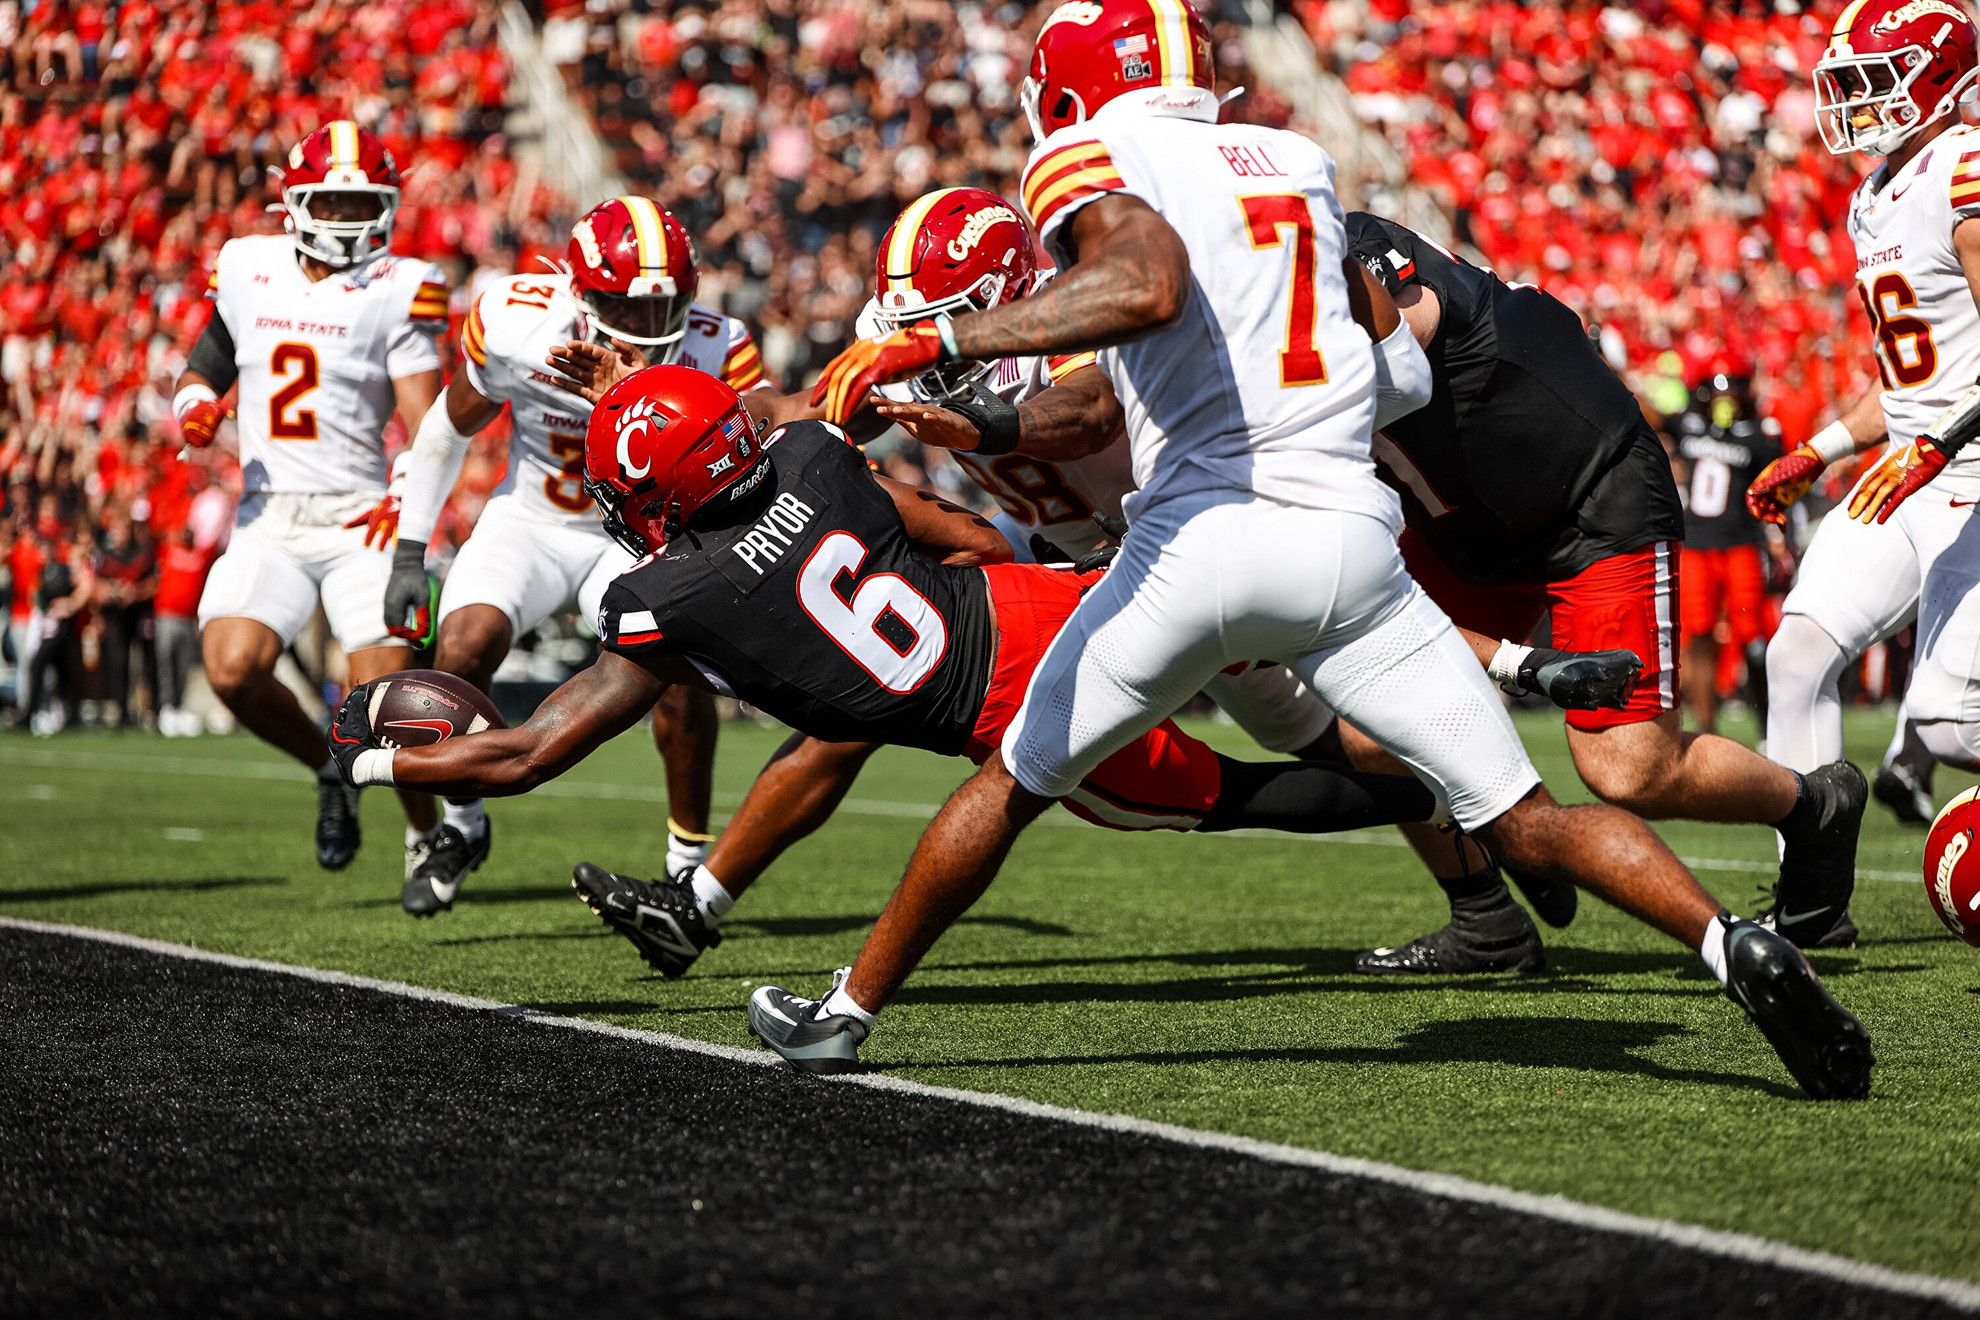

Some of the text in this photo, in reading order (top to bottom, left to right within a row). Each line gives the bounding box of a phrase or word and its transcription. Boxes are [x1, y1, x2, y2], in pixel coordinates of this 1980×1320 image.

[1217, 145, 1289, 176] BELL
[1871, 245, 1903, 267] STATE
[507, 281, 555, 310] 31
[1235, 192, 1330, 389] 7
[255, 317, 349, 338] IOWA STATE
[270, 339, 320, 441] 2
[705, 452, 736, 479] XII
[730, 458, 770, 501] BEARCATS
[1690, 456, 1731, 517] 0
[732, 492, 815, 576] PRYOR
[796, 529, 949, 696] 6
